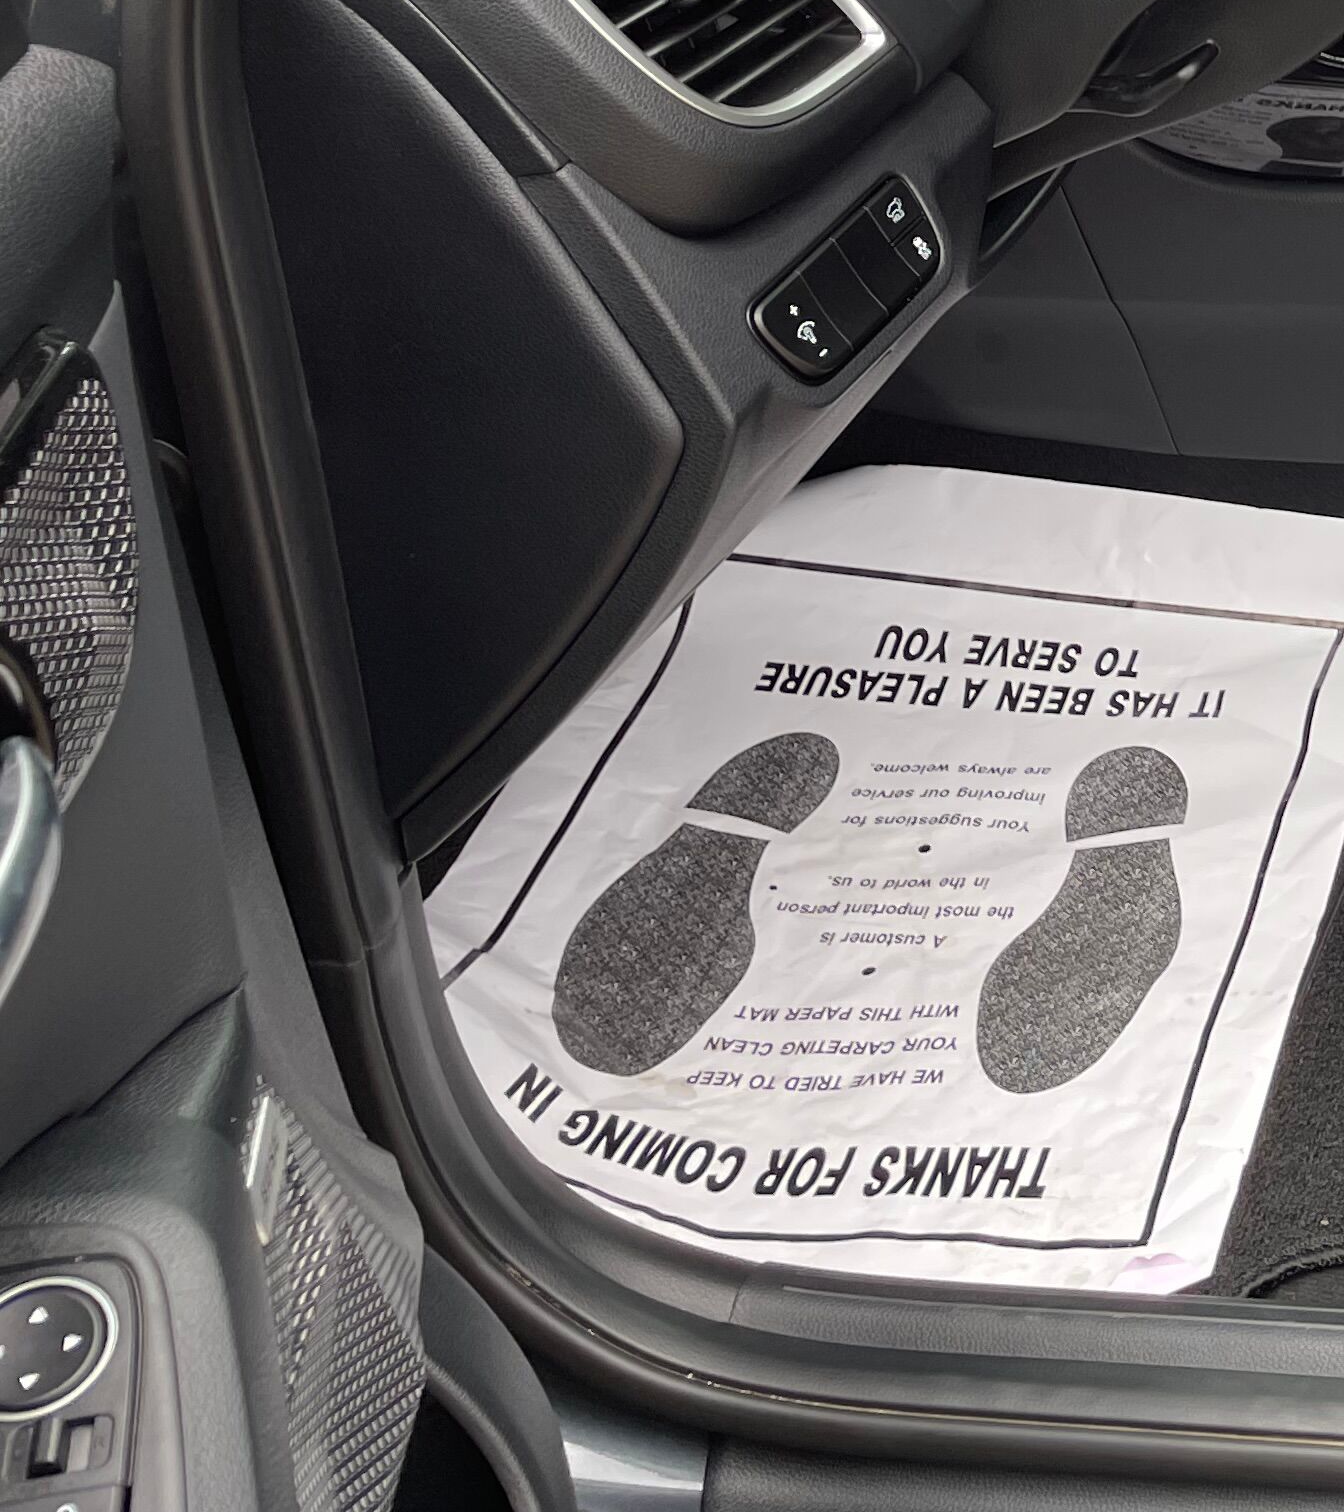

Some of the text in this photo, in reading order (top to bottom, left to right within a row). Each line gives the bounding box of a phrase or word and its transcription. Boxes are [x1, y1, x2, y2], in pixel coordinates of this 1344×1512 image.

[874, 625, 1140, 678] TO SERVE YOU
[754, 661, 1226, 720] IT HAS BEEN A PLEASURE
[870, 763, 1051, 777] are always welcome.
[851, 787, 1046, 805] improving our service
[841, 813, 1030, 832] Your suggestions for
[828, 876, 990, 890] in the world to us.
[777, 901, 1014, 918] the most important person
[820, 932, 946, 948] A customer is
[734, 1004, 960, 1022] WITH THIS PAPER MAT
[704, 1036, 959, 1057] YOUR CARPETING CLEAN
[686, 1068, 945, 1091] WE HAVE TRIED TO KEEP
[504, 1062, 1051, 1200] THANKS FOR COMING IN
